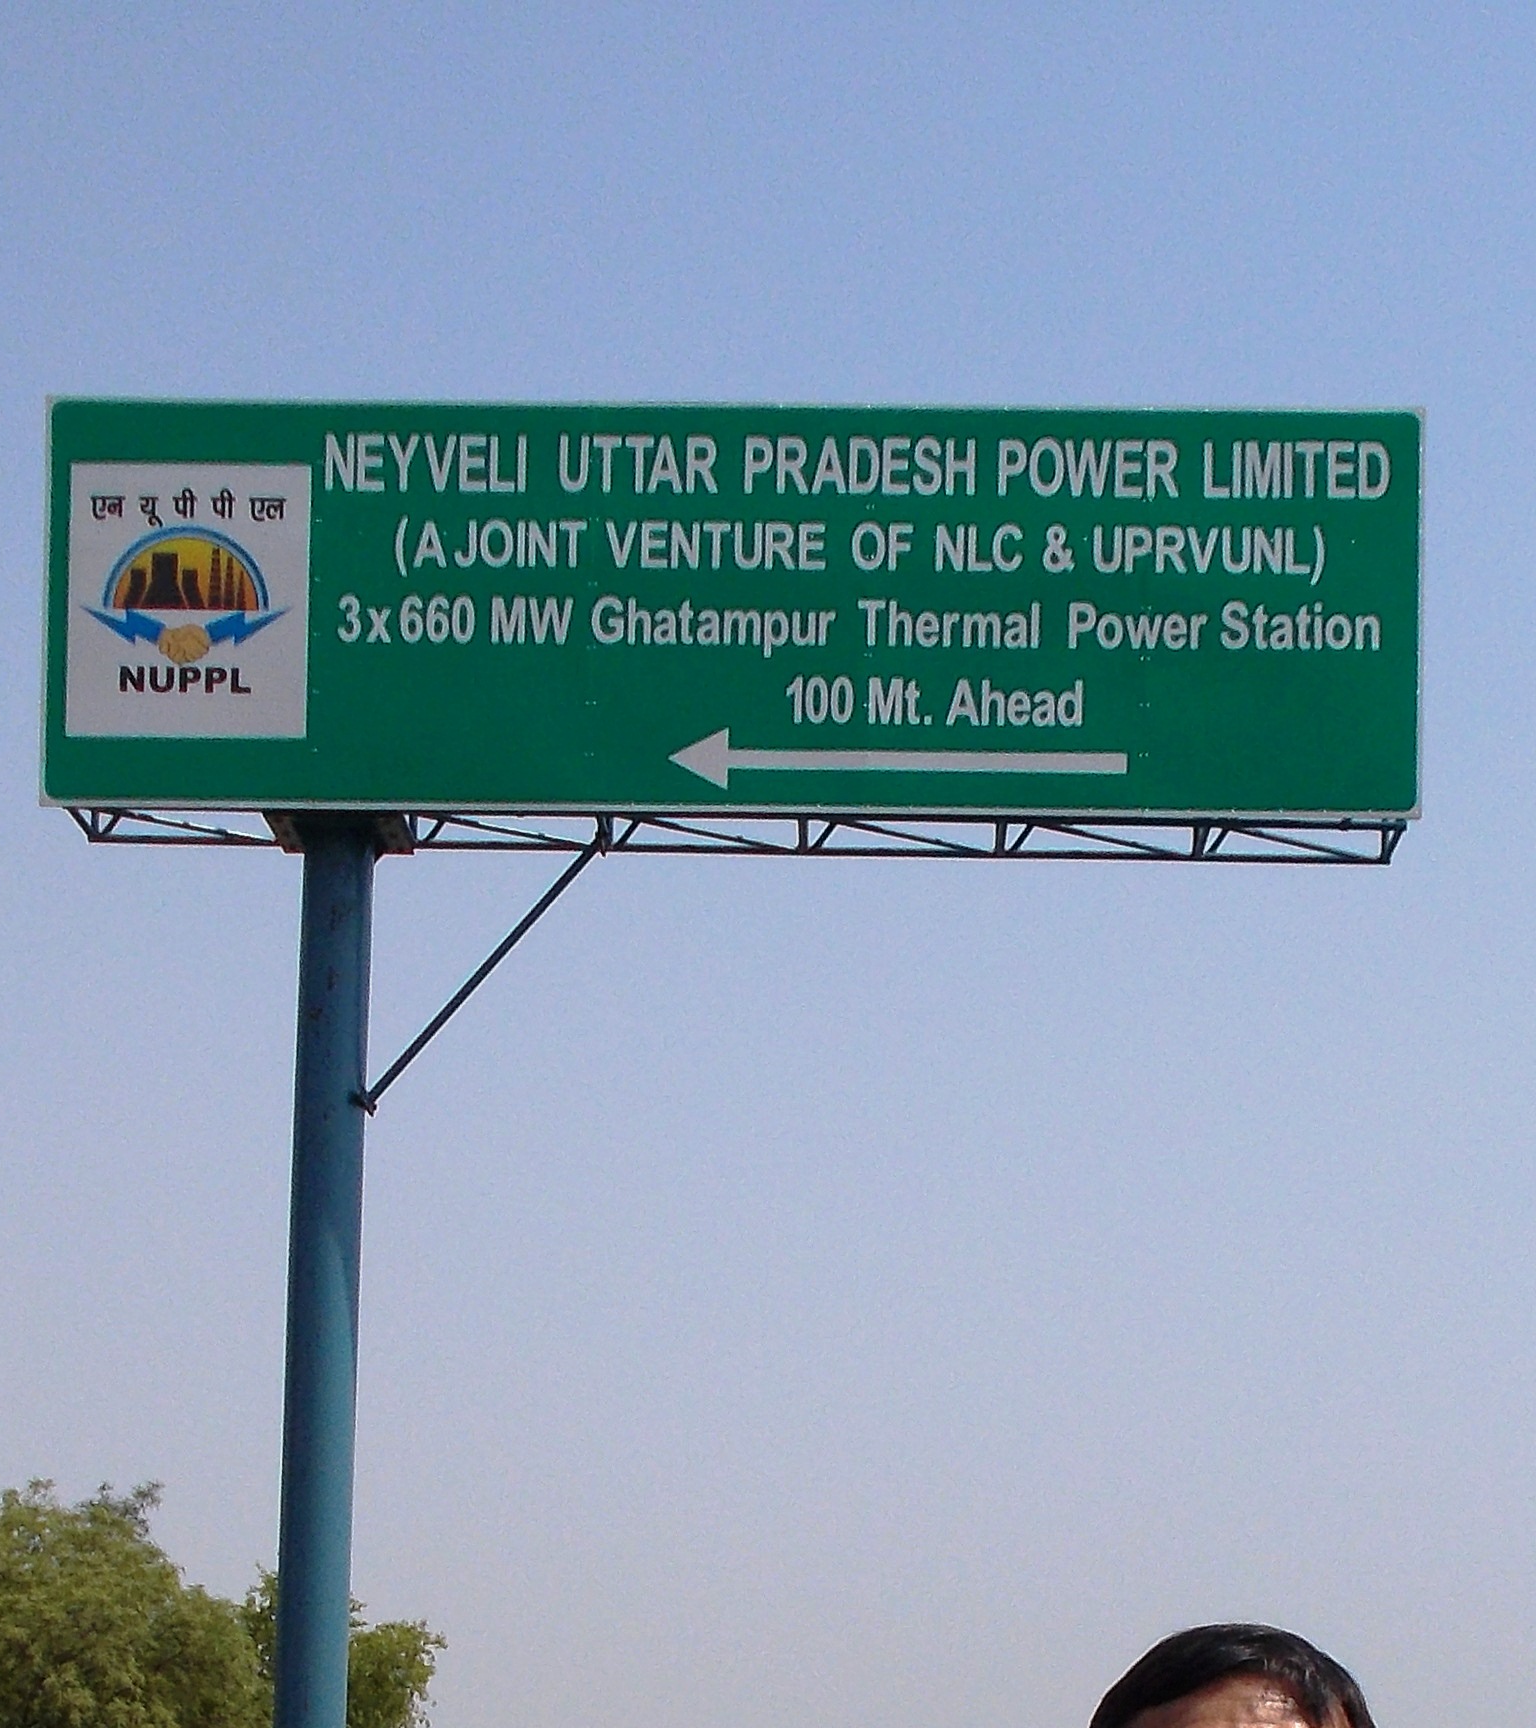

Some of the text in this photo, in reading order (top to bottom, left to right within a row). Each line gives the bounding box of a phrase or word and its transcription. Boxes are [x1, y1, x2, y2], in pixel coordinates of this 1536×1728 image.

[324, 432, 1392, 500] NEYVELI UTTAR PRADESH POWER LIMITED
[90, 487, 287, 527] एन यू पी पी एल
[604, 518, 826, 571] VENTURE
[851, 520, 914, 572] OF
[934, 522, 1023, 573] NLC
[1042, 523, 1076, 574] &
[1092, 523, 1326, 586] UPRVUNL)
[490, 596, 575, 646] MW
[591, 597, 837, 659] Ghatampur
[857, 598, 1041, 650] Thermal
[1067, 600, 1208, 651] Power
[1220, 599, 1382, 652] Station
[119, 665, 252, 694] NUPPL
[786, 675, 1085, 728] 100 Mt. Ahead
